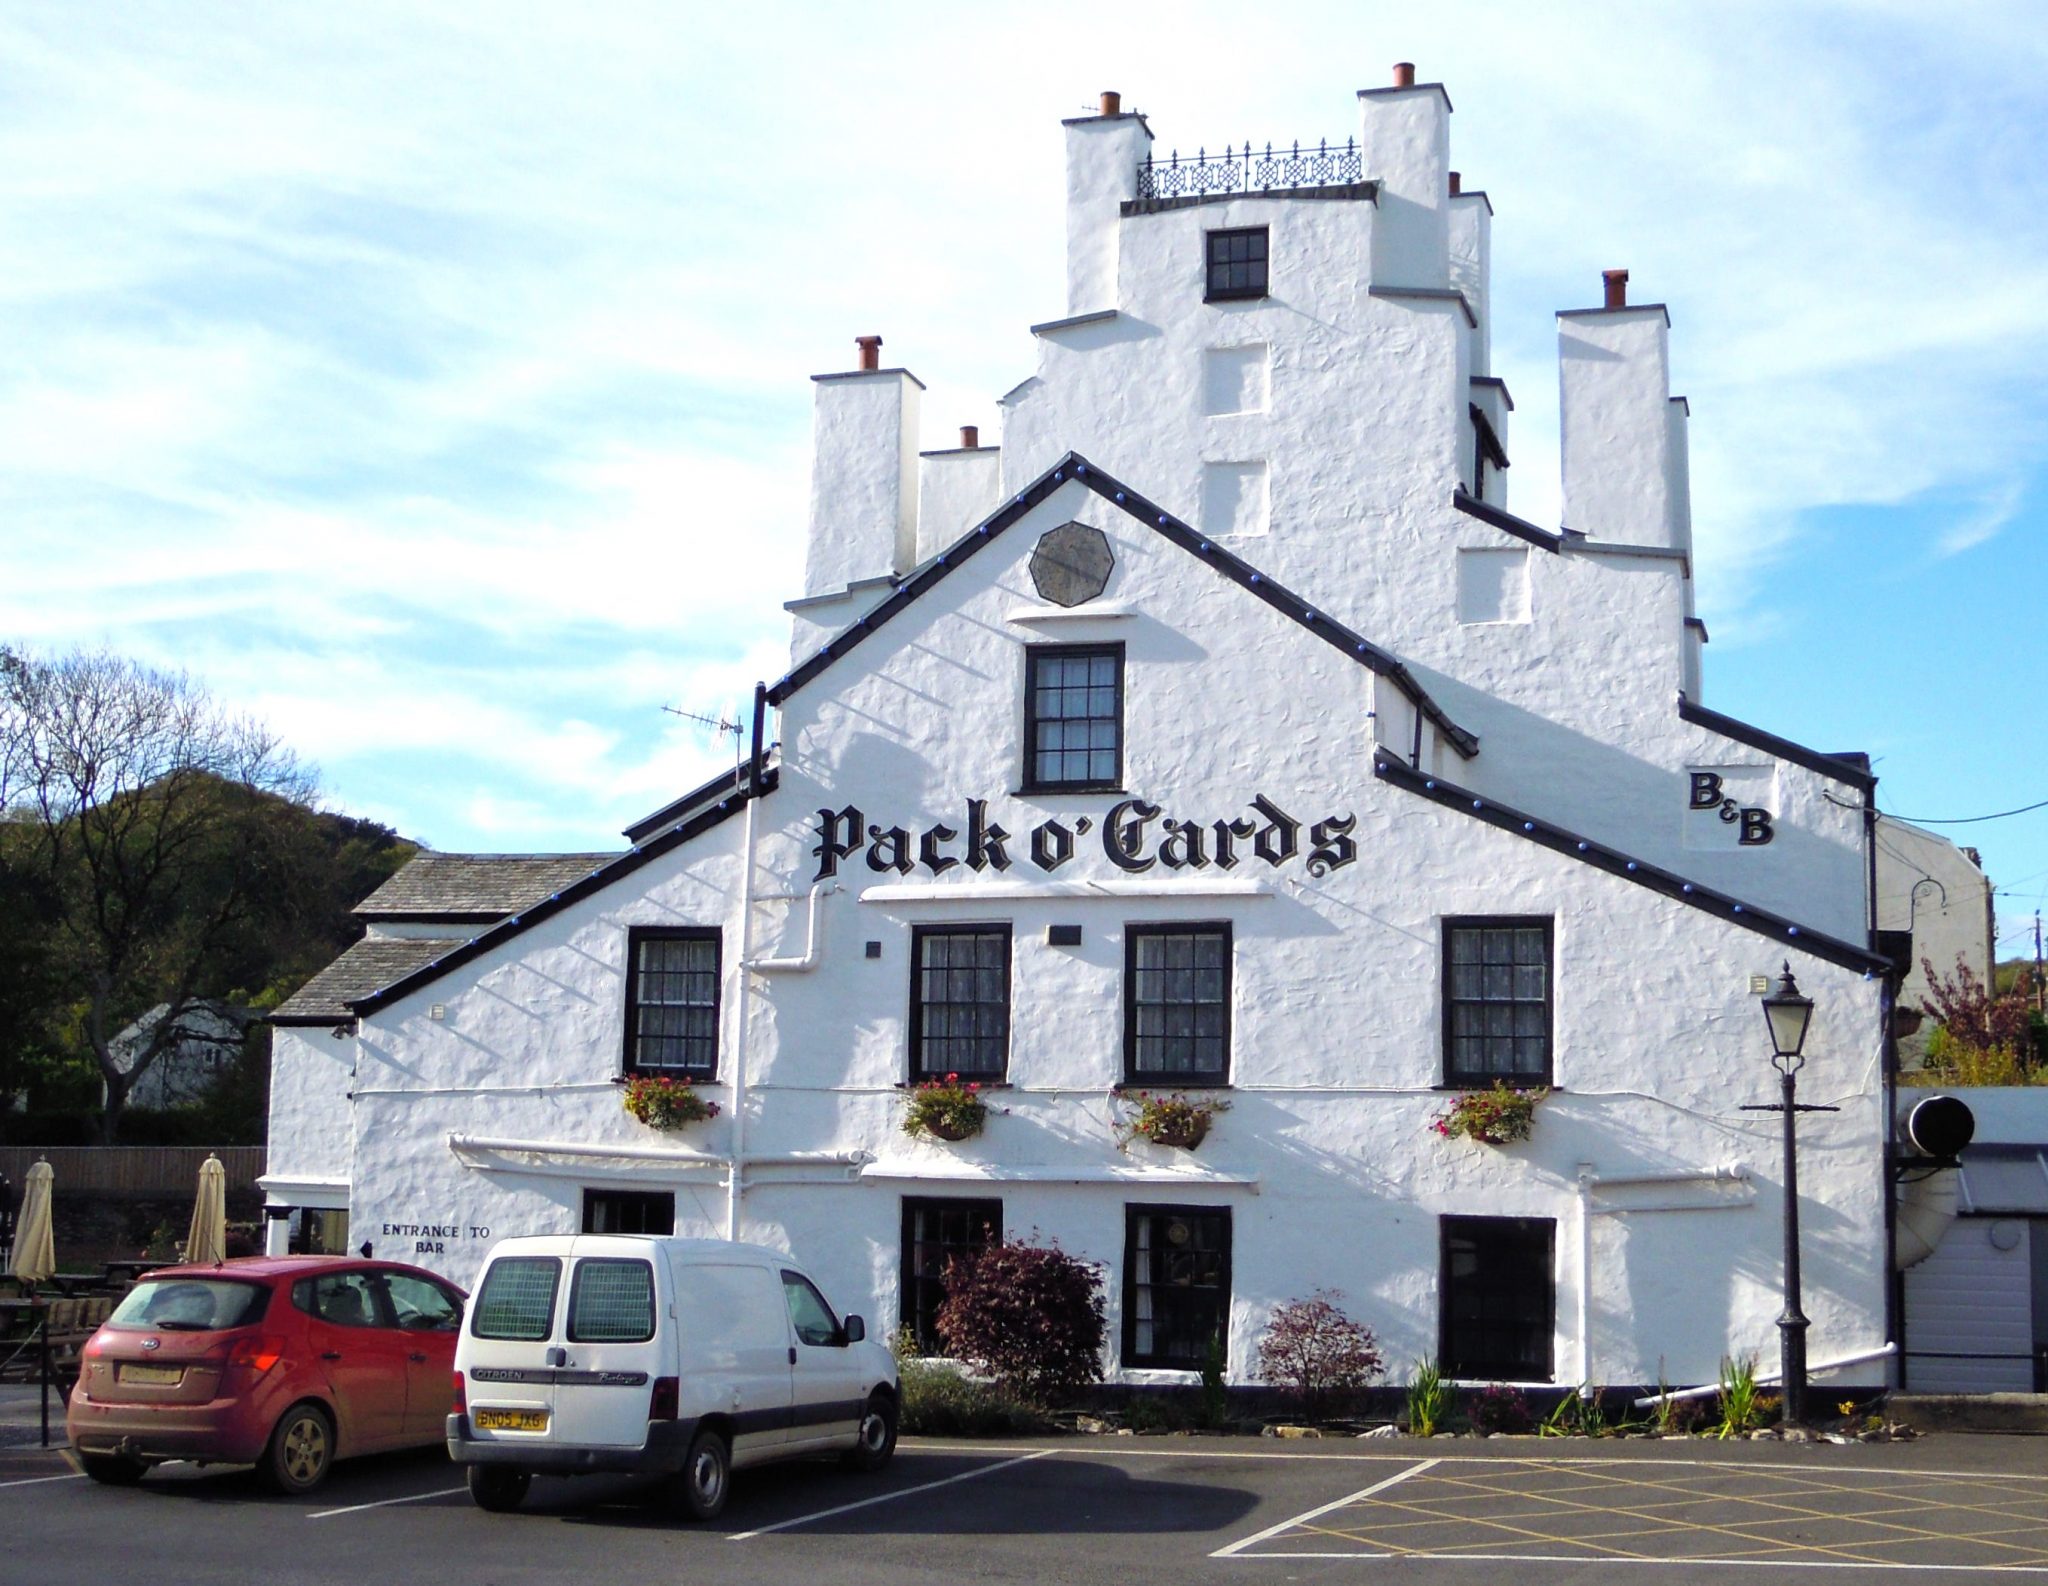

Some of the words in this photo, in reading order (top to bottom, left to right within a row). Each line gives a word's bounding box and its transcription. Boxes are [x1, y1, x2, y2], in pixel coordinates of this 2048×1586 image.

[1689, 772, 1775, 846] B&B
[812, 797, 1013, 883] Pack
[1029, 814, 1093, 874] o'
[1101, 792, 1358, 879] Cards
[382, 1223, 460, 1238] ENTRANCE
[469, 1226, 490, 1239] TO
[415, 1241, 445, 1254] BAR
